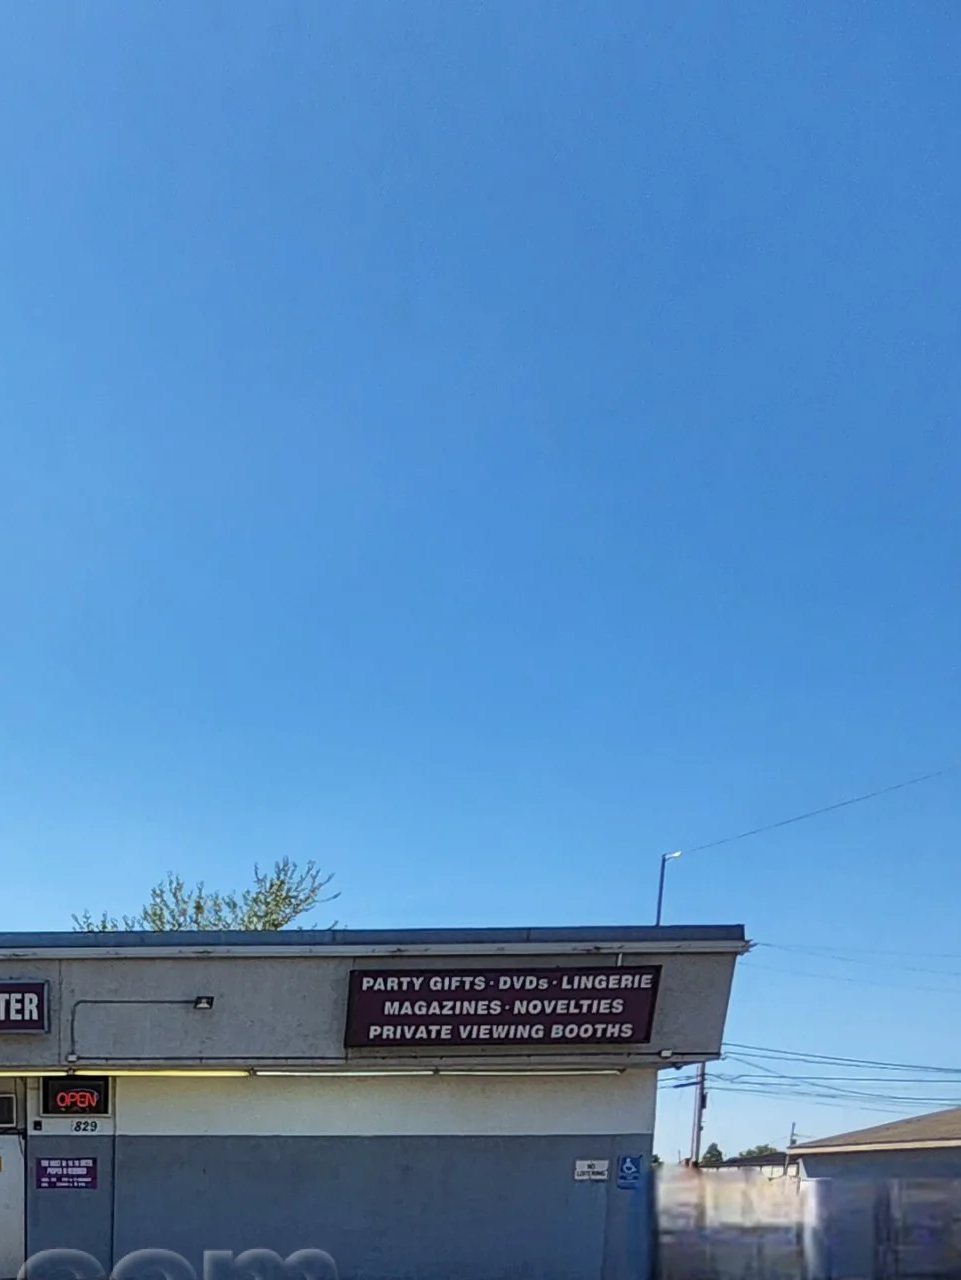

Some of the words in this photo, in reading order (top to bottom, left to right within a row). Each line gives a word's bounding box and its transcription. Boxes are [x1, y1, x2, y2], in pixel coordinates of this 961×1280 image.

[362, 977, 424, 991] PARTY
[429, 977, 486, 991] GIFTS
[498, 976, 549, 990] DVDs
[561, 974, 653, 989] LINGERIE
[384, 1000, 502, 1015] MAGAZINES
[513, 999, 624, 1014] NOVELTIES
[369, 1025, 452, 1039] PRIVATE
[458, 1024, 544, 1039] VIEWING
[550, 1023, 634, 1038] BOOTHS
[57, 1091, 97, 1107] OPEN
[74, 1121, 98, 1132] 829
